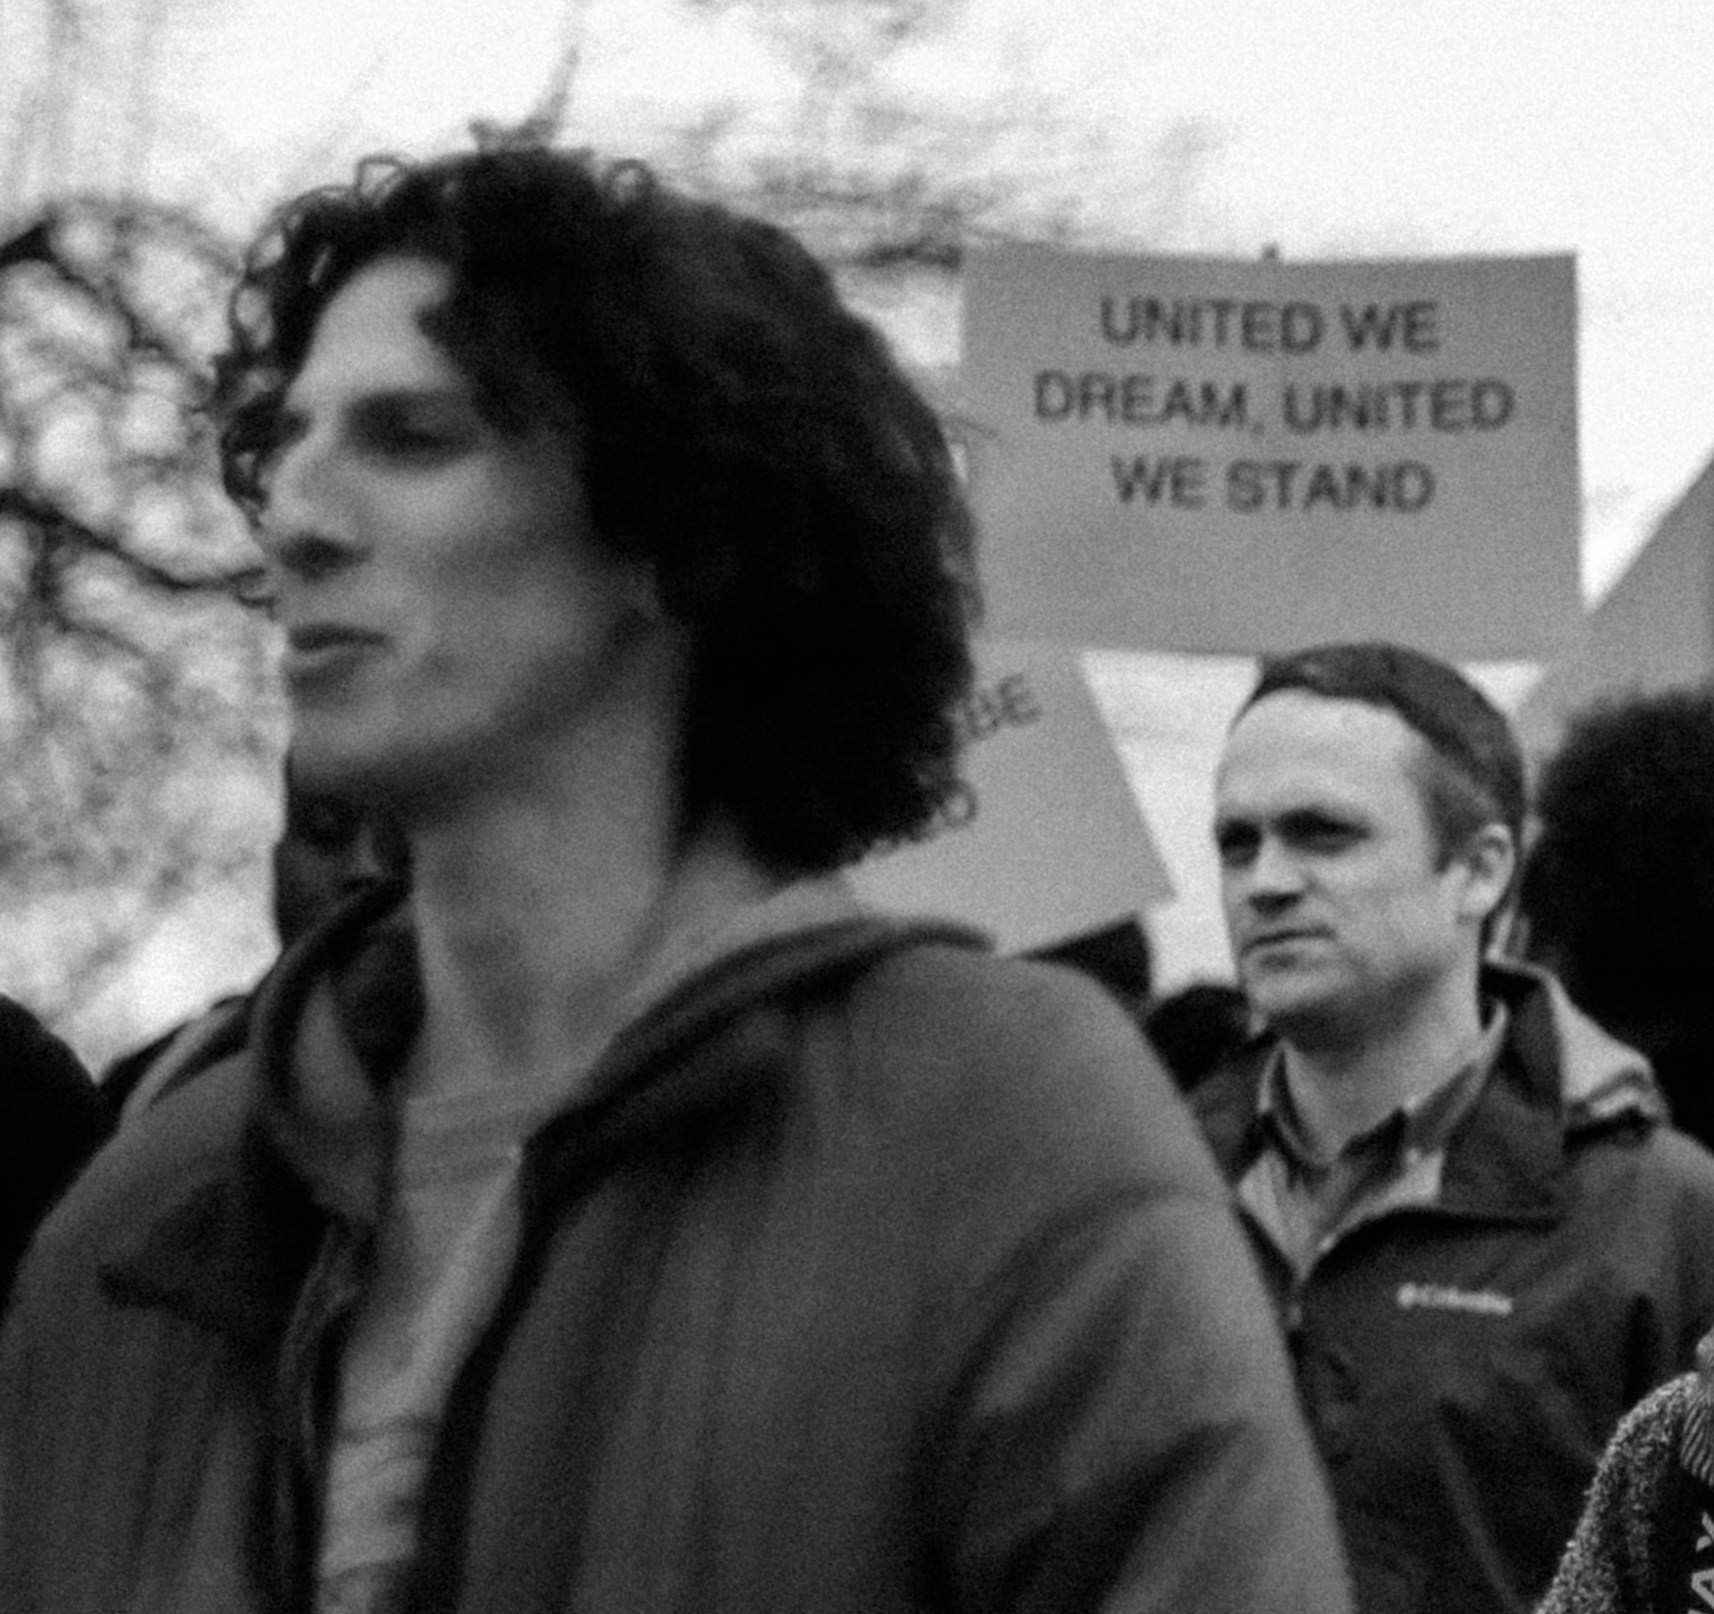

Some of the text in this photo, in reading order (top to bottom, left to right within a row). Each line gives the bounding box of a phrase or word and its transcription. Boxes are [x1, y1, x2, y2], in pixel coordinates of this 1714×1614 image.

[1100, 296, 1440, 355] UNITED WE
[1283, 378, 1517, 435] UNITED
[1110, 455, 1437, 514] WE STAND
